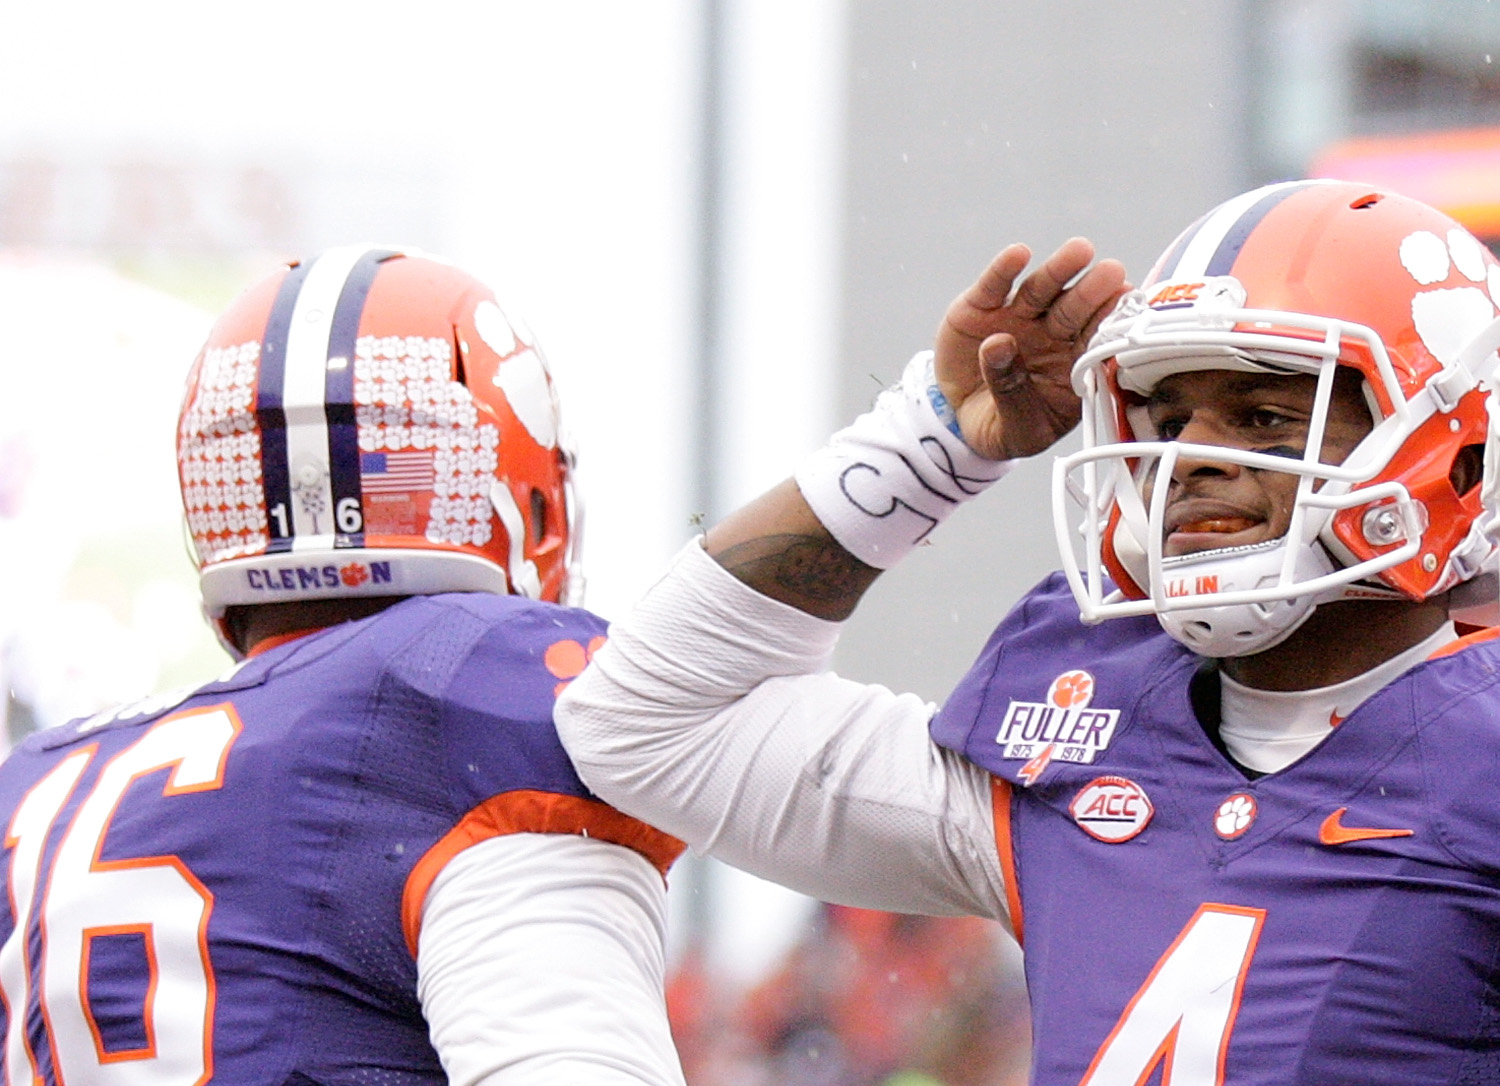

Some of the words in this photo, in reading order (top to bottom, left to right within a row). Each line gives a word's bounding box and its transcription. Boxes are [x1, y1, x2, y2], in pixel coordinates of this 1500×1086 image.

[1195, 574, 1219, 596] IN
[1003, 705, 1112, 747] FULLER
[1083, 793, 1142, 817] ACC
